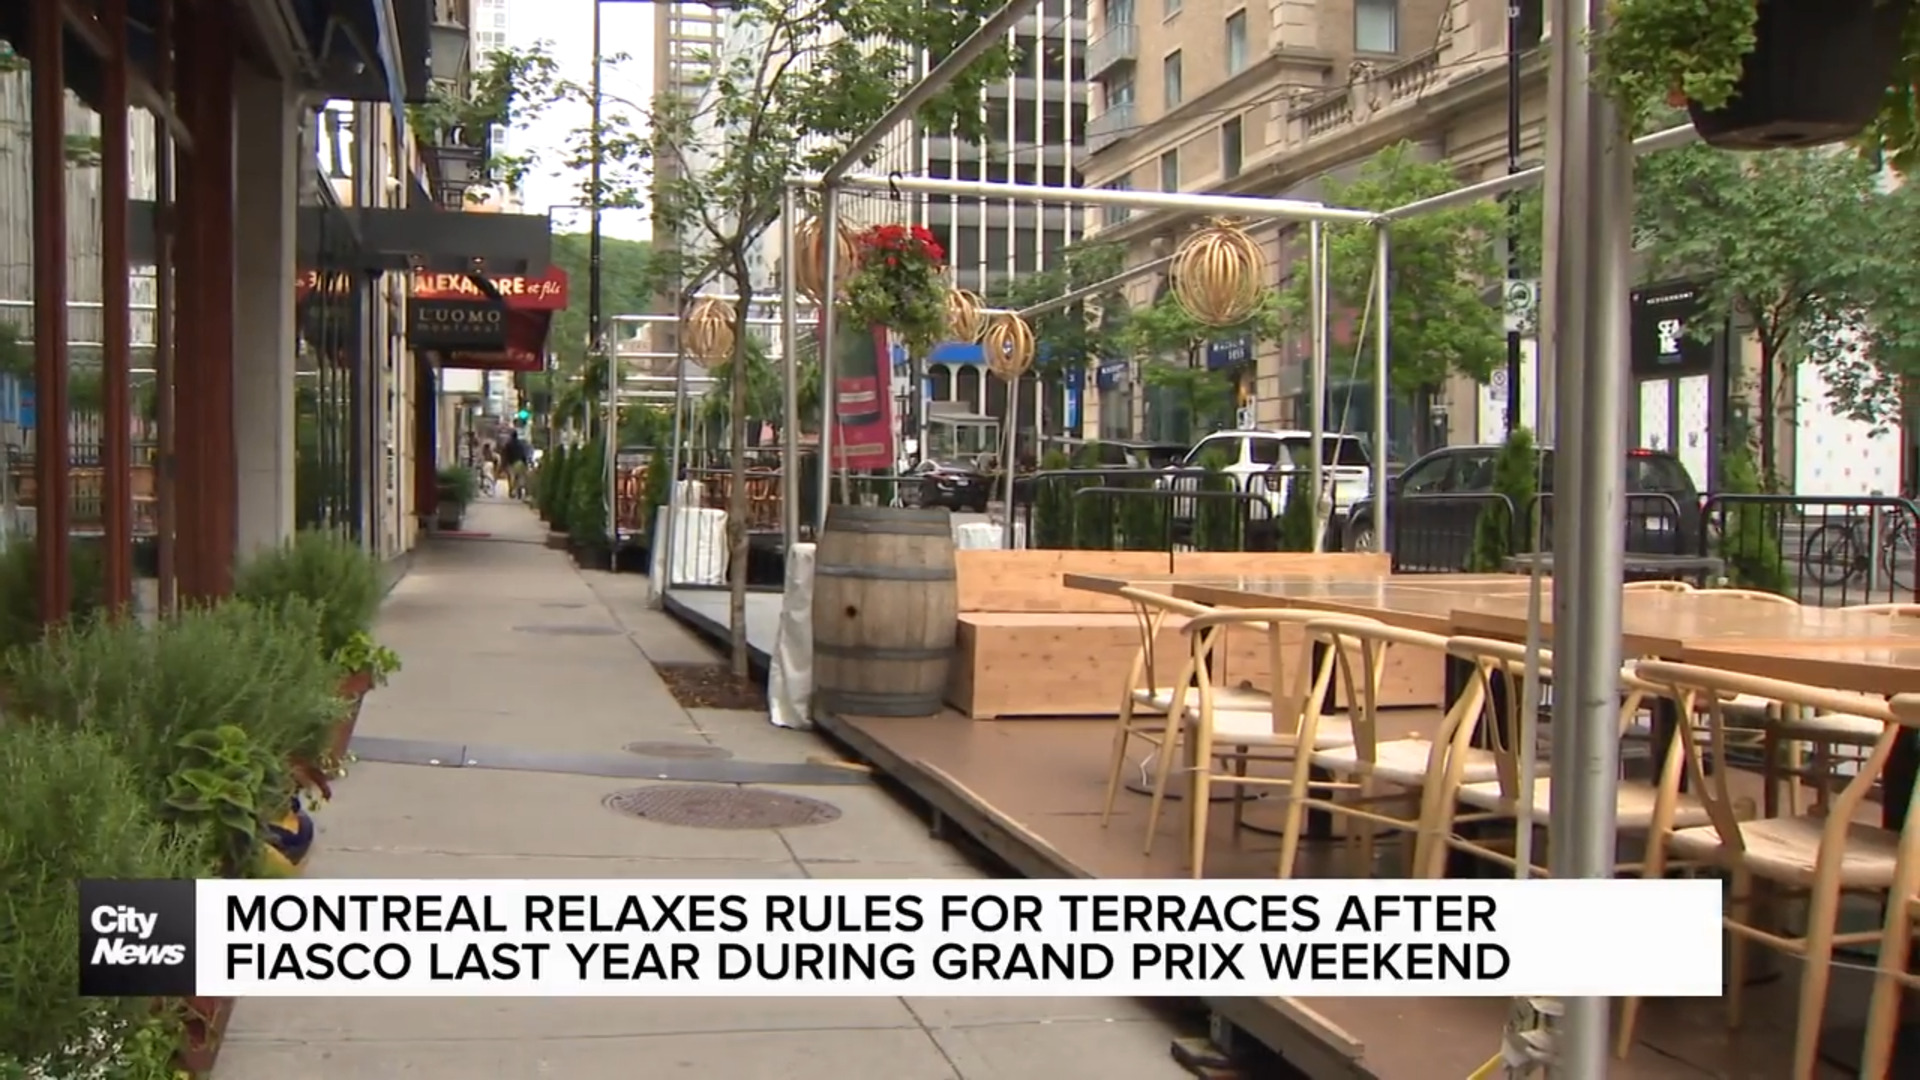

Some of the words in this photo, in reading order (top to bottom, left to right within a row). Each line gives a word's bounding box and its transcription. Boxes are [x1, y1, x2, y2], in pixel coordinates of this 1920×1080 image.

[415, 273, 524, 296] ALEXARE
[526, 282, 541, 295] et
[538, 280, 561, 301] fils
